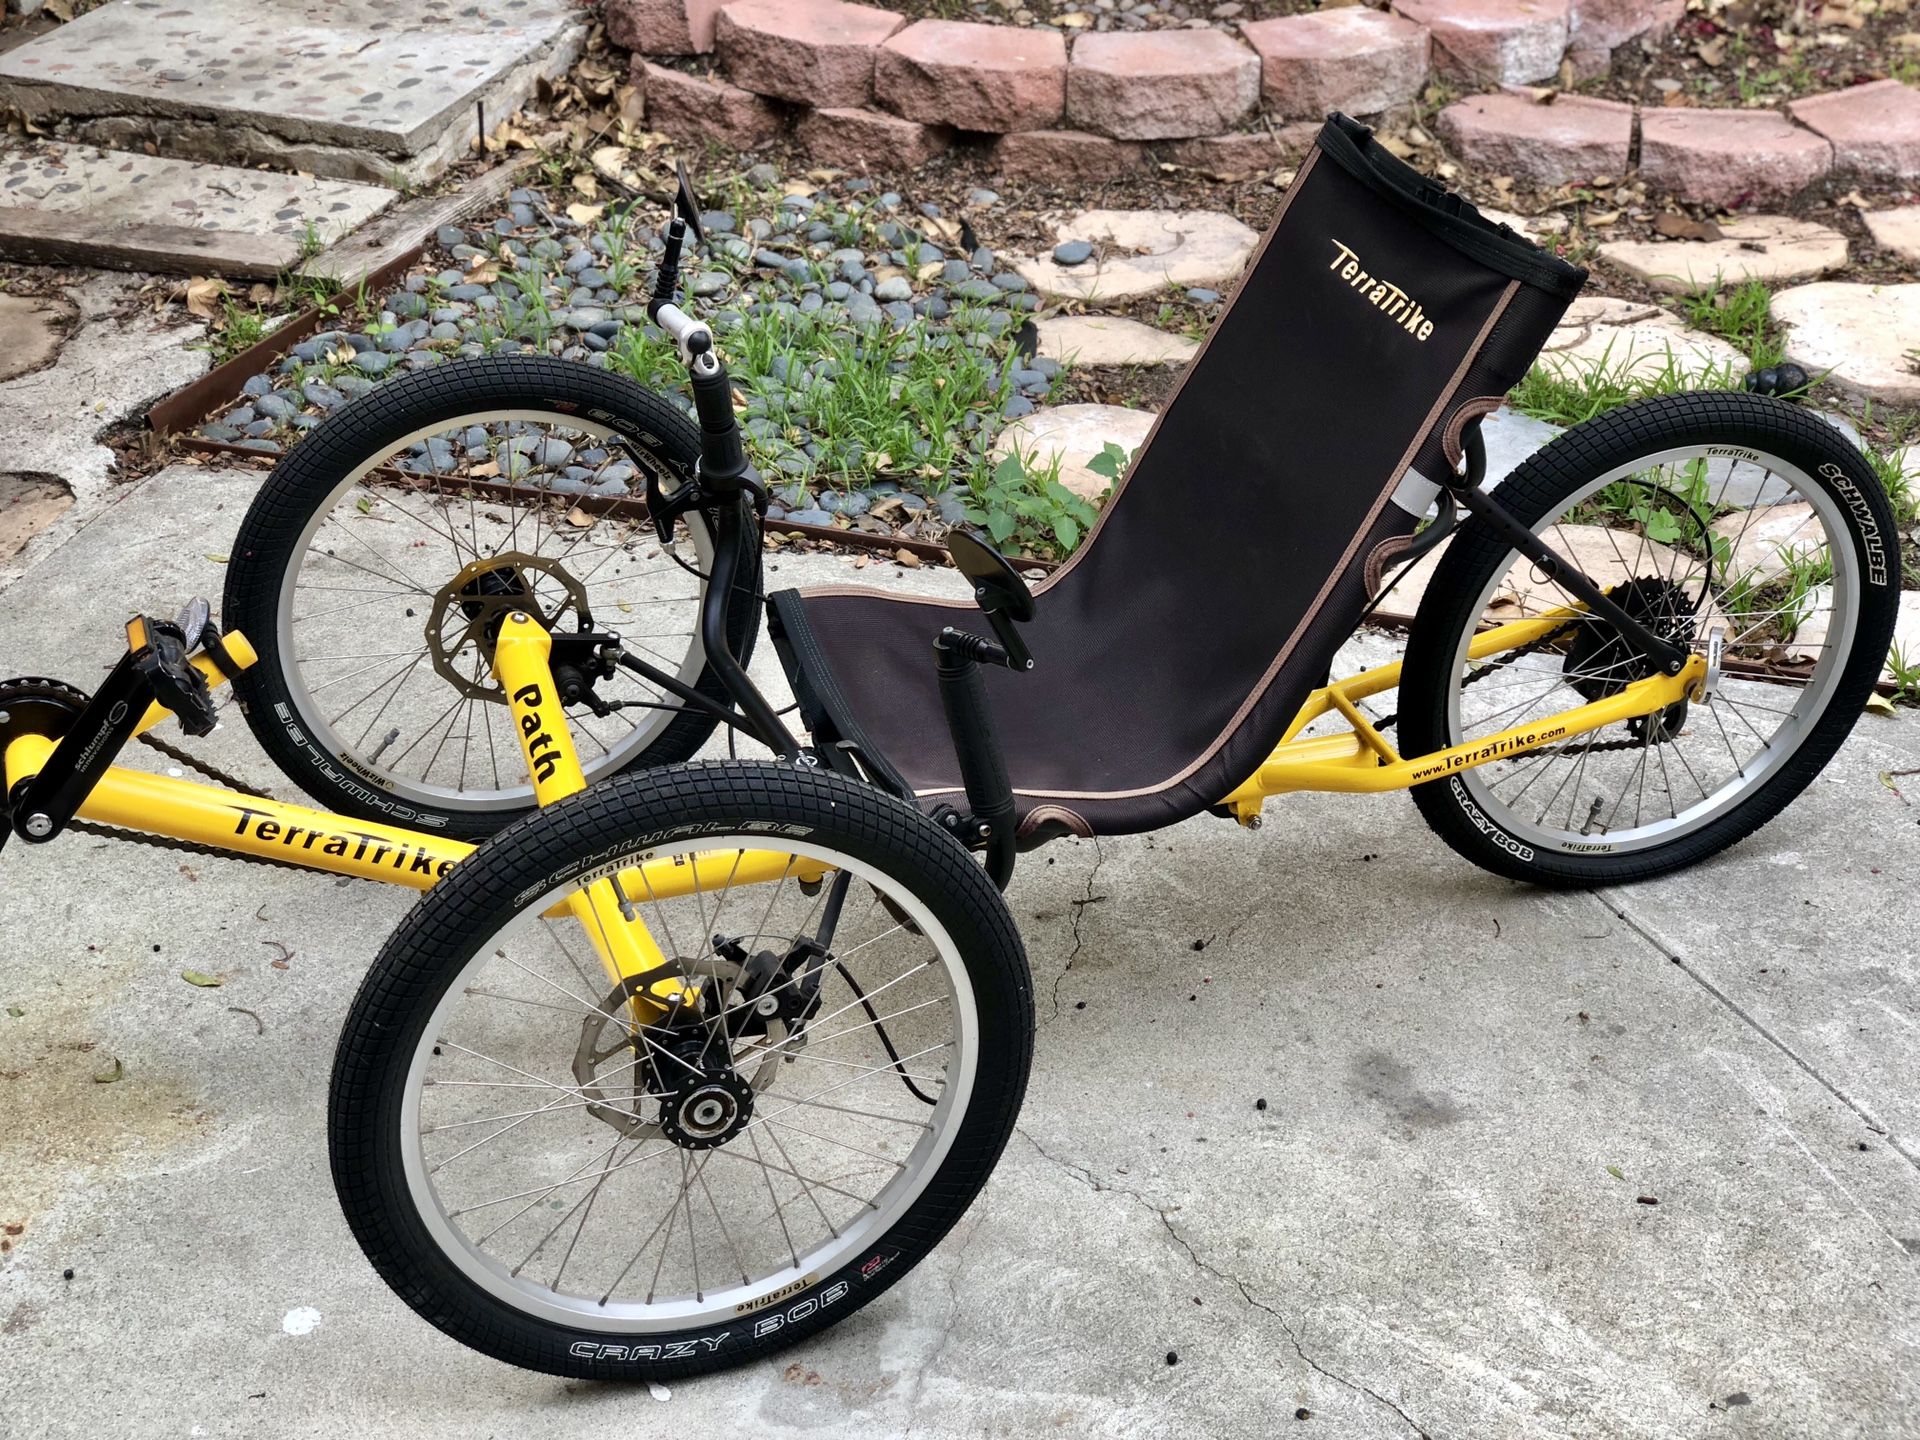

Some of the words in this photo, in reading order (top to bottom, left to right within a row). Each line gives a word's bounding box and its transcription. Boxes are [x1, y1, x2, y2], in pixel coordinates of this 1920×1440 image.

[1330, 238, 1434, 341] TerraTrike
[1706, 447, 1759, 462] TerraTrike
[1818, 462, 1888, 586] SCHWALBE
[75, 718, 110, 770] schlumpf
[274, 702, 449, 828] SCHWALBE
[339, 752, 386, 787] WizWheelz
[513, 683, 562, 784] Path
[1412, 726, 1566, 779] www.TerraTrike.com
[226, 805, 456, 878] TerraTrike
[1450, 776, 1496, 834] CRAZY
[1492, 830, 1534, 861] BOB
[1562, 841, 1612, 853] TerraTrike
[513, 821, 814, 908] SCHWALBE
[573, 851, 654, 887] TerraTrike
[569, 1332, 730, 1361] CRAZY
[754, 1281, 849, 1339] BOB
[736, 1278, 815, 1312] TerraTrike
